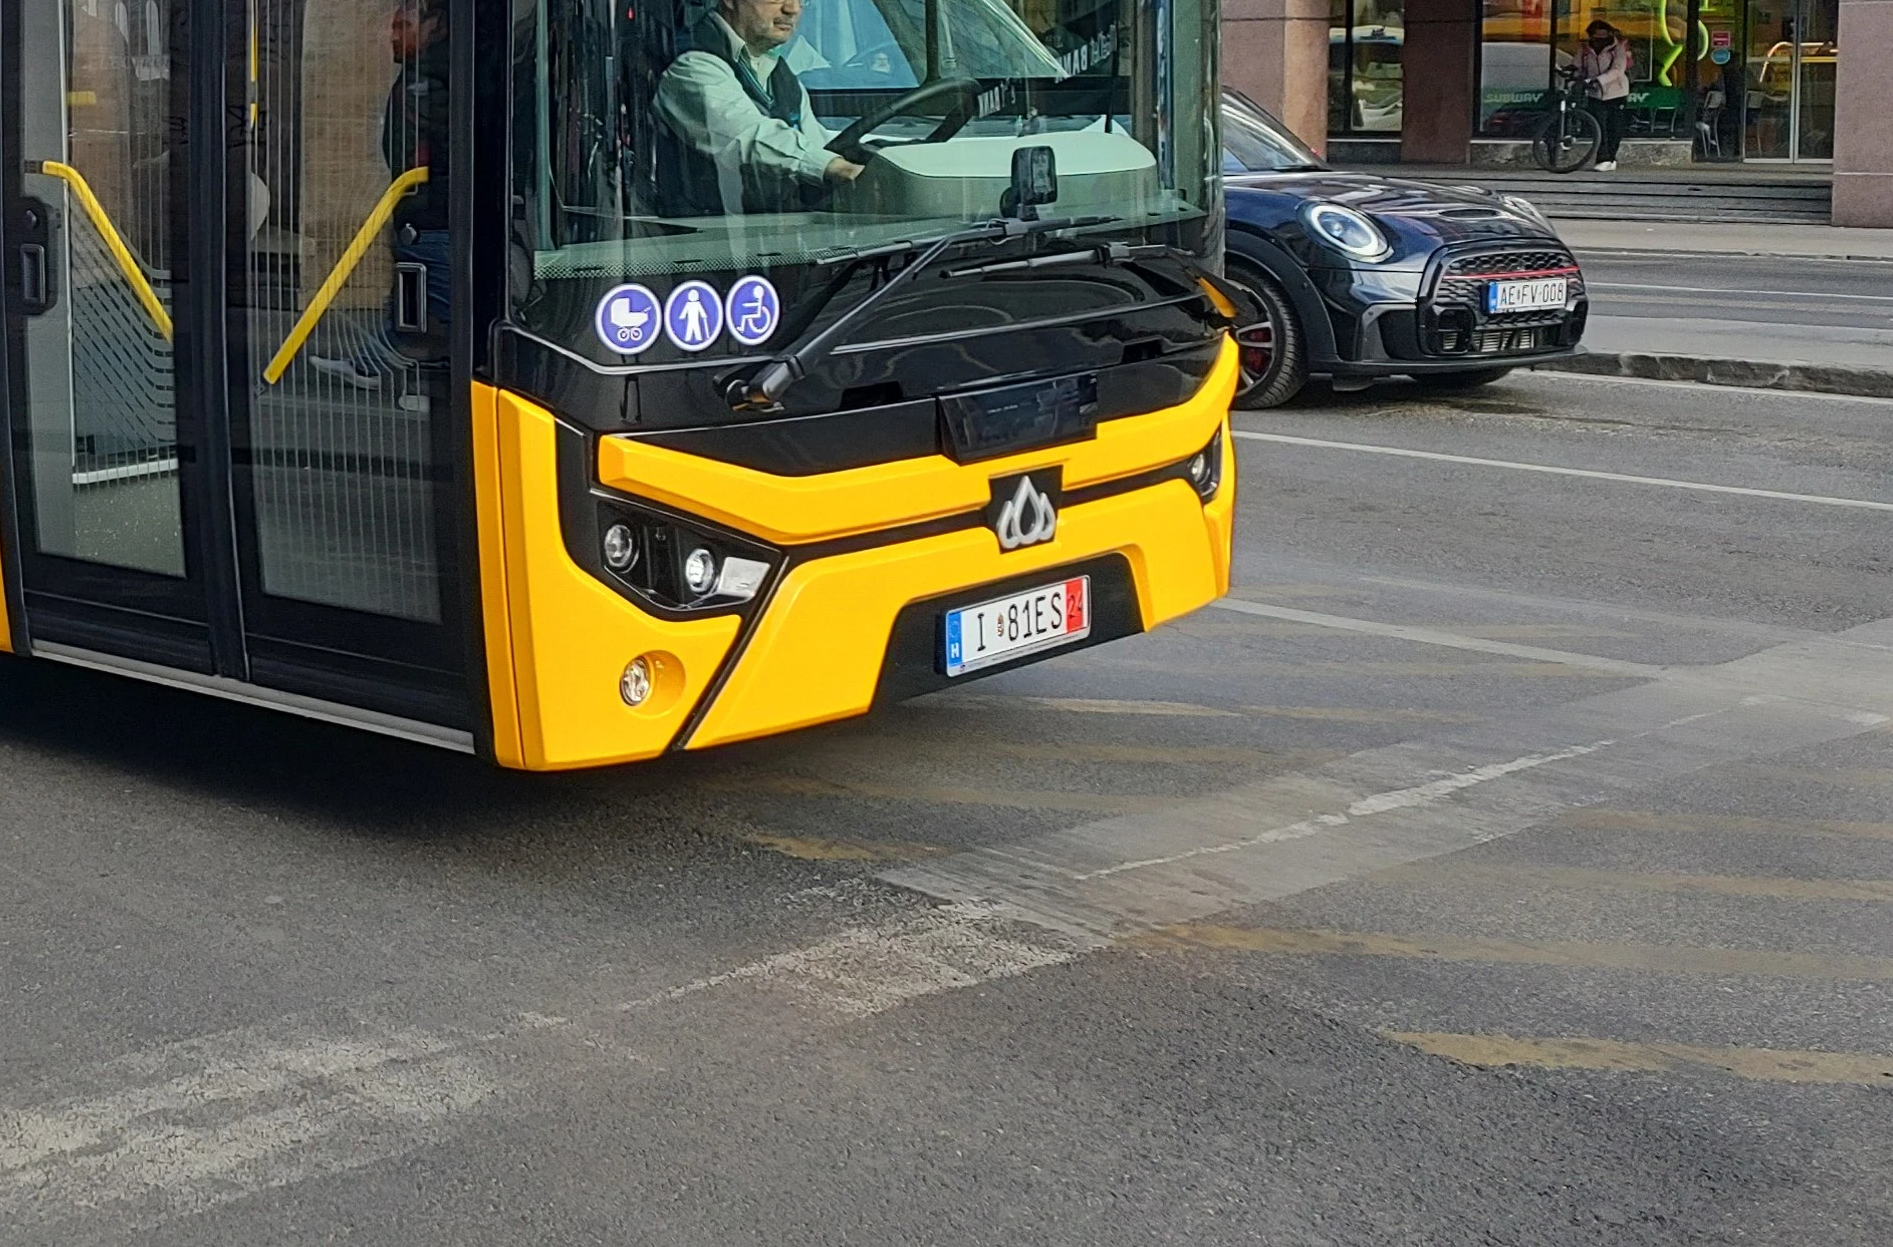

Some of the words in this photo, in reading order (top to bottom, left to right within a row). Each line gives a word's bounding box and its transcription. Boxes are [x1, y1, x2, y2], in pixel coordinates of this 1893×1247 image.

[1484, 92, 1544, 103] SUBWAY
[1500, 285, 1515, 306] AE
[1008, 592, 1063, 642] 81ES
[951, 642, 960, 659] H
